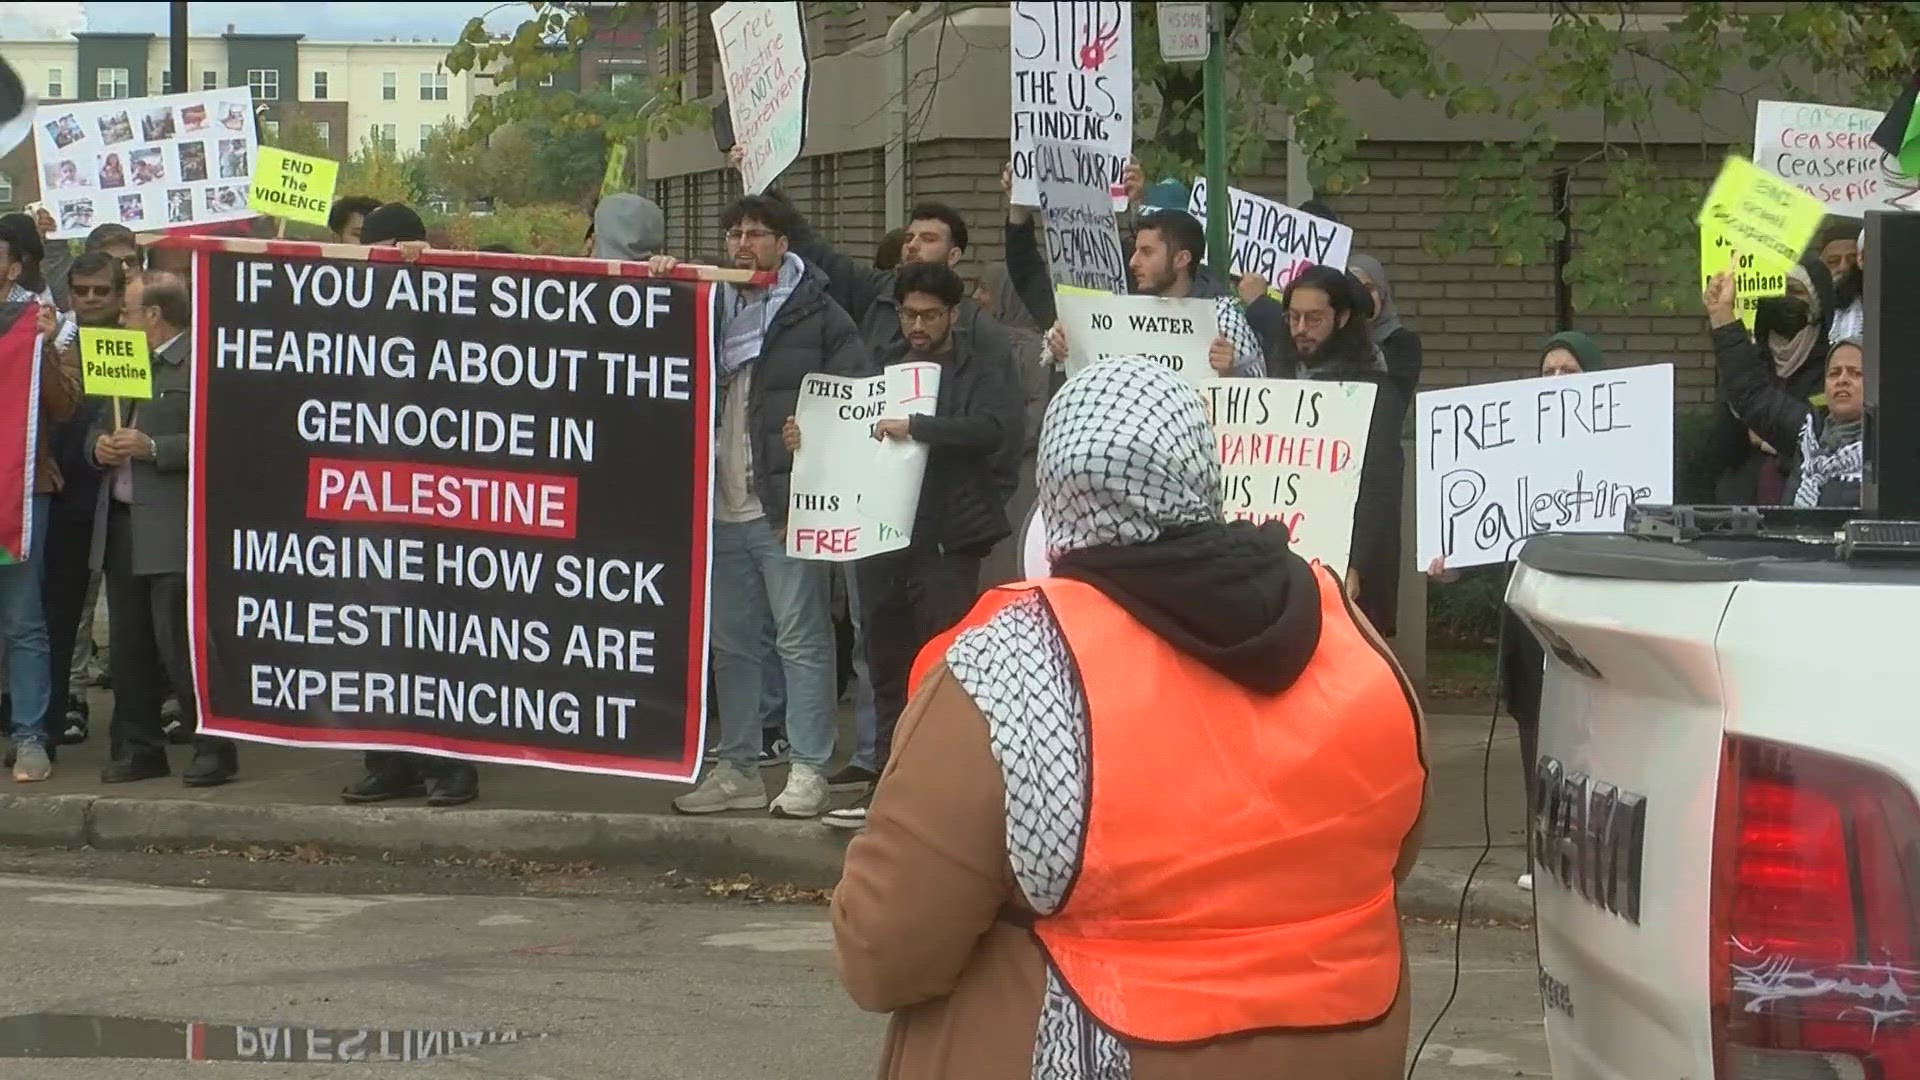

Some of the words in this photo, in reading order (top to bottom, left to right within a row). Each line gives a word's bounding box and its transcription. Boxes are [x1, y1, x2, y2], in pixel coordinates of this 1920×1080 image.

[750, 65, 773, 106] NOT
[1015, 69, 1057, 105] THE
[1068, 73, 1122, 121] U.S.
[279, 174, 308, 191] The
[281, 157, 313, 175] END
[1072, 146, 1110, 194] YOUR
[255, 186, 327, 213] VIOLENCE
[1046, 226, 1122, 282] DEMAND
[236, 261, 274, 303] IF
[283, 263, 374, 309] YOU
[385, 269, 477, 316] ARE
[489, 275, 598, 324] SICK
[608, 284, 671, 329] OF
[1091, 313, 1113, 330] NO
[1129, 315, 1194, 335] WATER
[95, 338, 134, 357] FREE
[216, 327, 415, 379] HEARING
[427, 339, 588, 392] ABOUT
[597, 352, 690, 401] THE
[87, 361, 147, 380] Palestine
[807, 379, 852, 400] THIS
[868, 380, 885, 398] IS
[1208, 386, 1271, 426] THIS
[1295, 389, 1323, 428] IS
[1431, 401, 1515, 471] FREE
[1538, 381, 1632, 444] FREE
[297, 399, 535, 457] GENOCIDE
[549, 416, 594, 462] IN
[1221, 432, 1352, 473] PARTHEID
[319, 468, 566, 528] PALESTINE
[793, 493, 840, 512] THIS
[1273, 473, 1301, 507] IS
[796, 526, 861, 554] FREE
[233, 529, 424, 582] IMAGINE
[437, 543, 543, 594] HOW
[554, 554, 664, 606] SICK
[236, 596, 550, 663] PALESTINIANS
[562, 624, 655, 674] ARE
[251, 664, 580, 735] EXPERIENCING
[596, 695, 636, 740] IT
